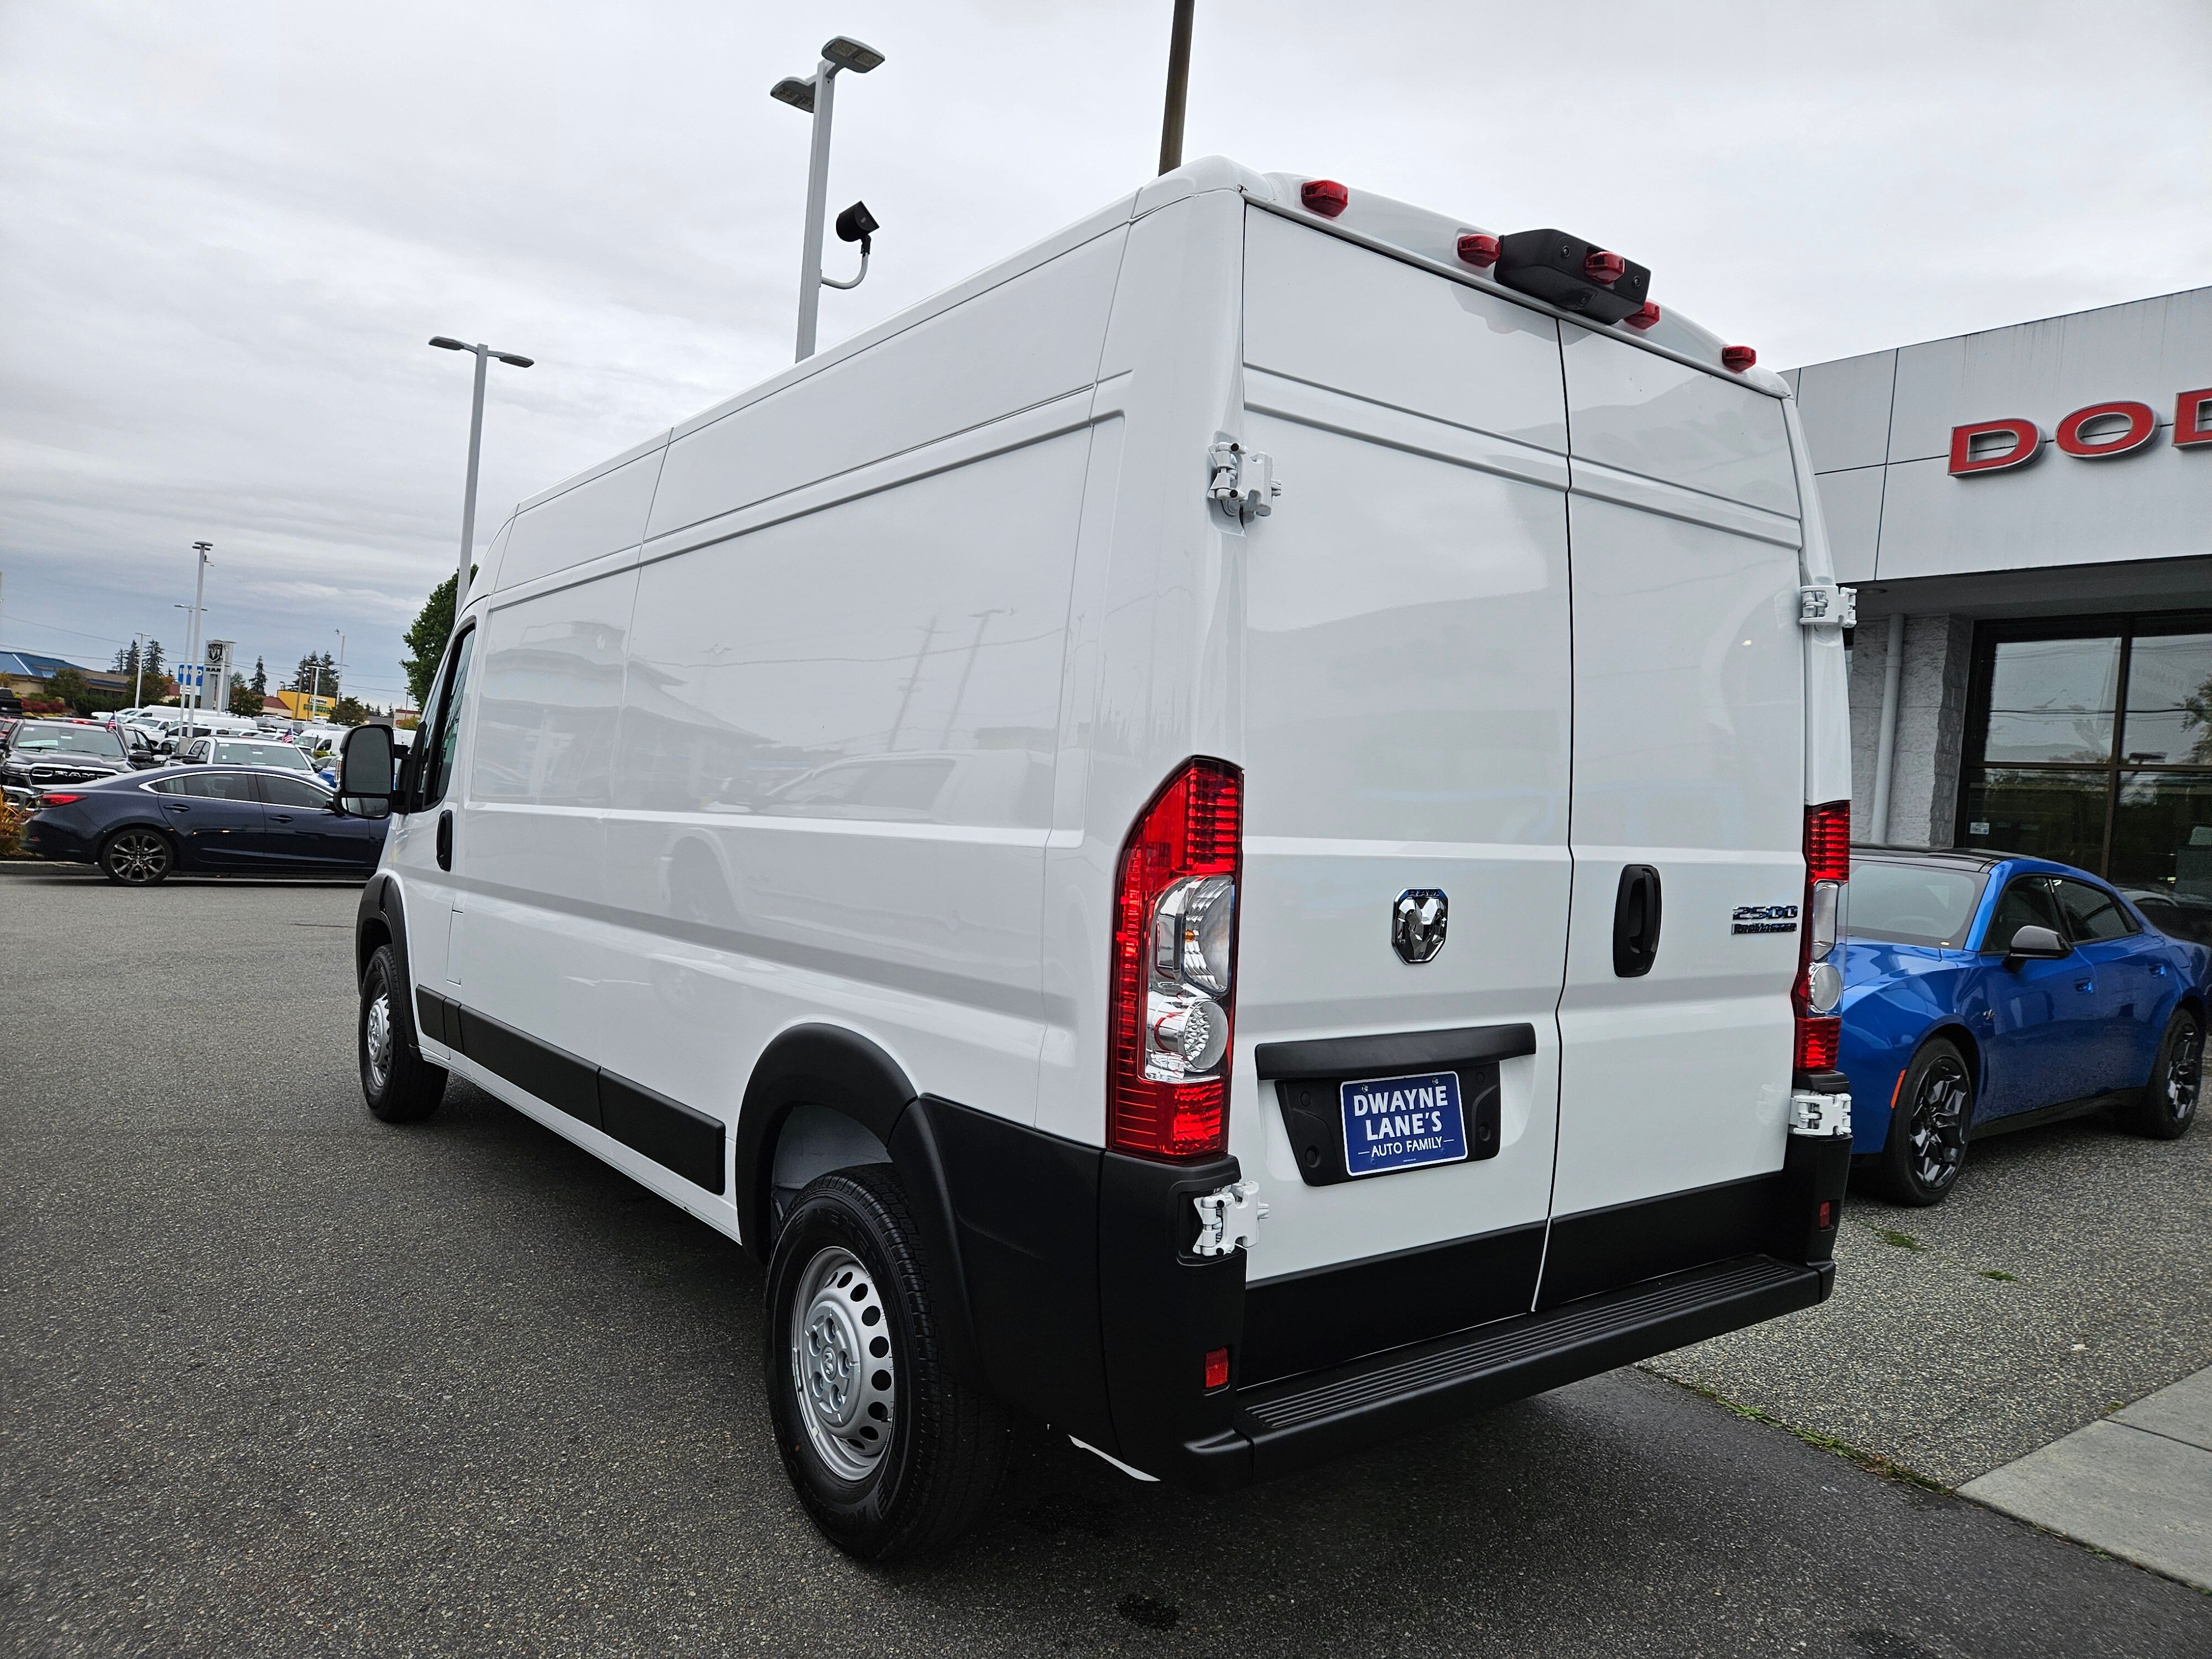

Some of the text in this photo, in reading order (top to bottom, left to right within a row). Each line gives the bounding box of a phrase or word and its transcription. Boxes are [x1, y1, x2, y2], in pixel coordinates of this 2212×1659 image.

[55, 770, 96, 779] RAM
[1733, 905, 1798, 921] 2500
[1353, 1086, 1448, 1117] DWAYNE
[1365, 1111, 1442, 1141] LANE'S
[1371, 1136, 1442, 1158] AUTO FAMILY
